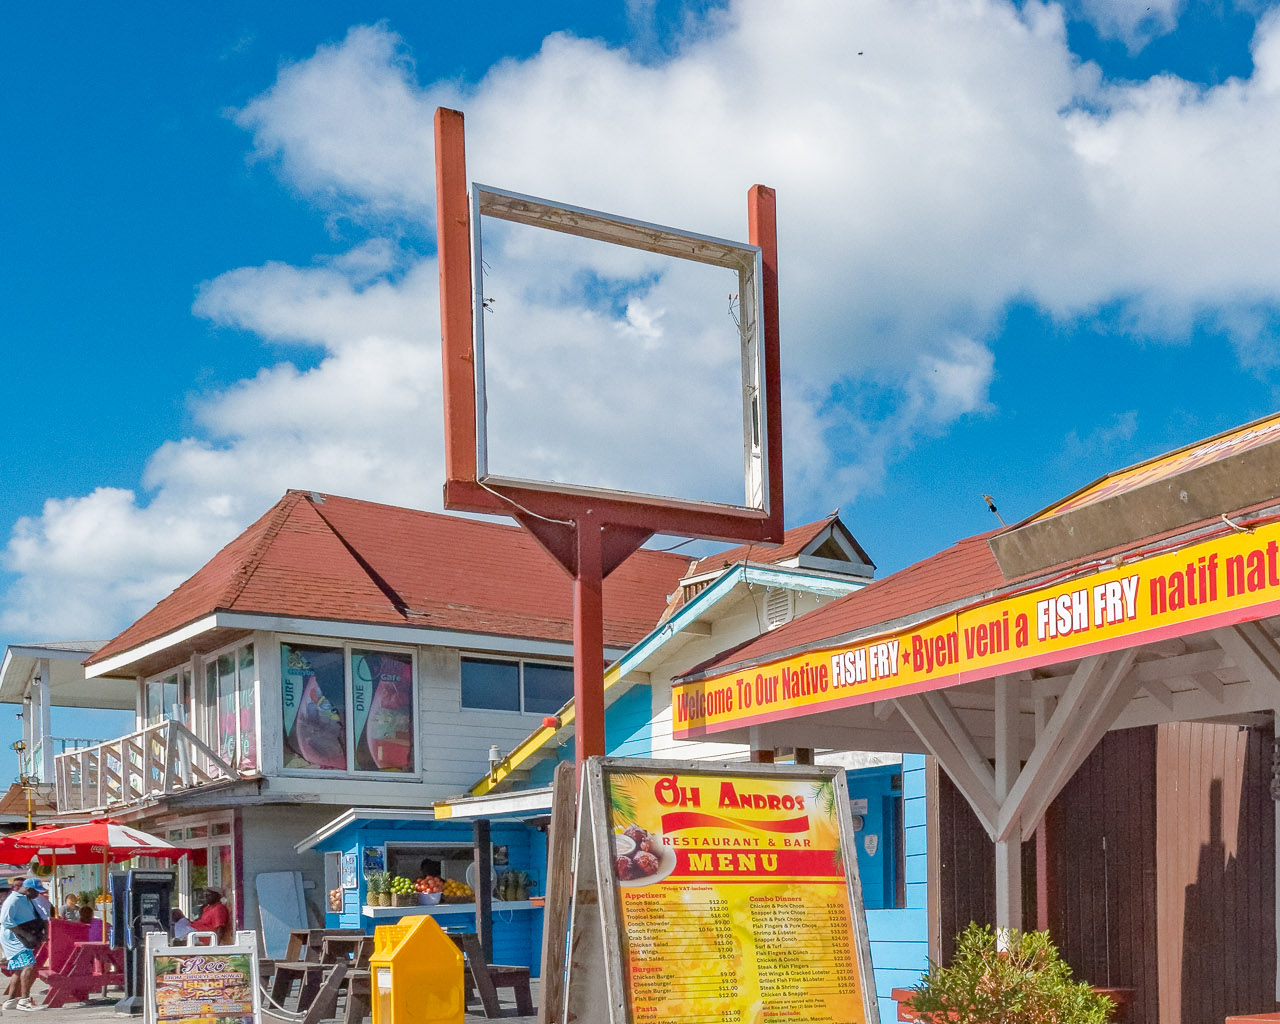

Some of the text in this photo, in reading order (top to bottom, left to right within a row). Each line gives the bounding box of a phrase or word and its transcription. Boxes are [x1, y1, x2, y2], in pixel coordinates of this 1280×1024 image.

[677, 689, 733, 723] Welcome
[737, 678, 751, 709] To
[755, 674, 779, 706] Our
[782, 663, 829, 700] Native
[831, 647, 868, 689] FISH
[869, 640, 901, 681] FRY
[912, 631, 959, 673] Byen
[964, 611, 1009, 659] veni
[1016, 613, 1028, 647] a
[1037, 589, 1089, 642] FISH
[1093, 575, 1140, 626] FRY
[1150, 553, 1219, 616] natif
[286, 680, 294, 707] SURF
[356, 685, 364, 711] DINE
[663, 837, 811, 848] RESTAURANT & BAR
[688, 853, 779, 871] MENU
[625, 892, 666, 900] Appetizers
[182, 957, 226, 972] Reo
[183, 980, 224, 989] Island
